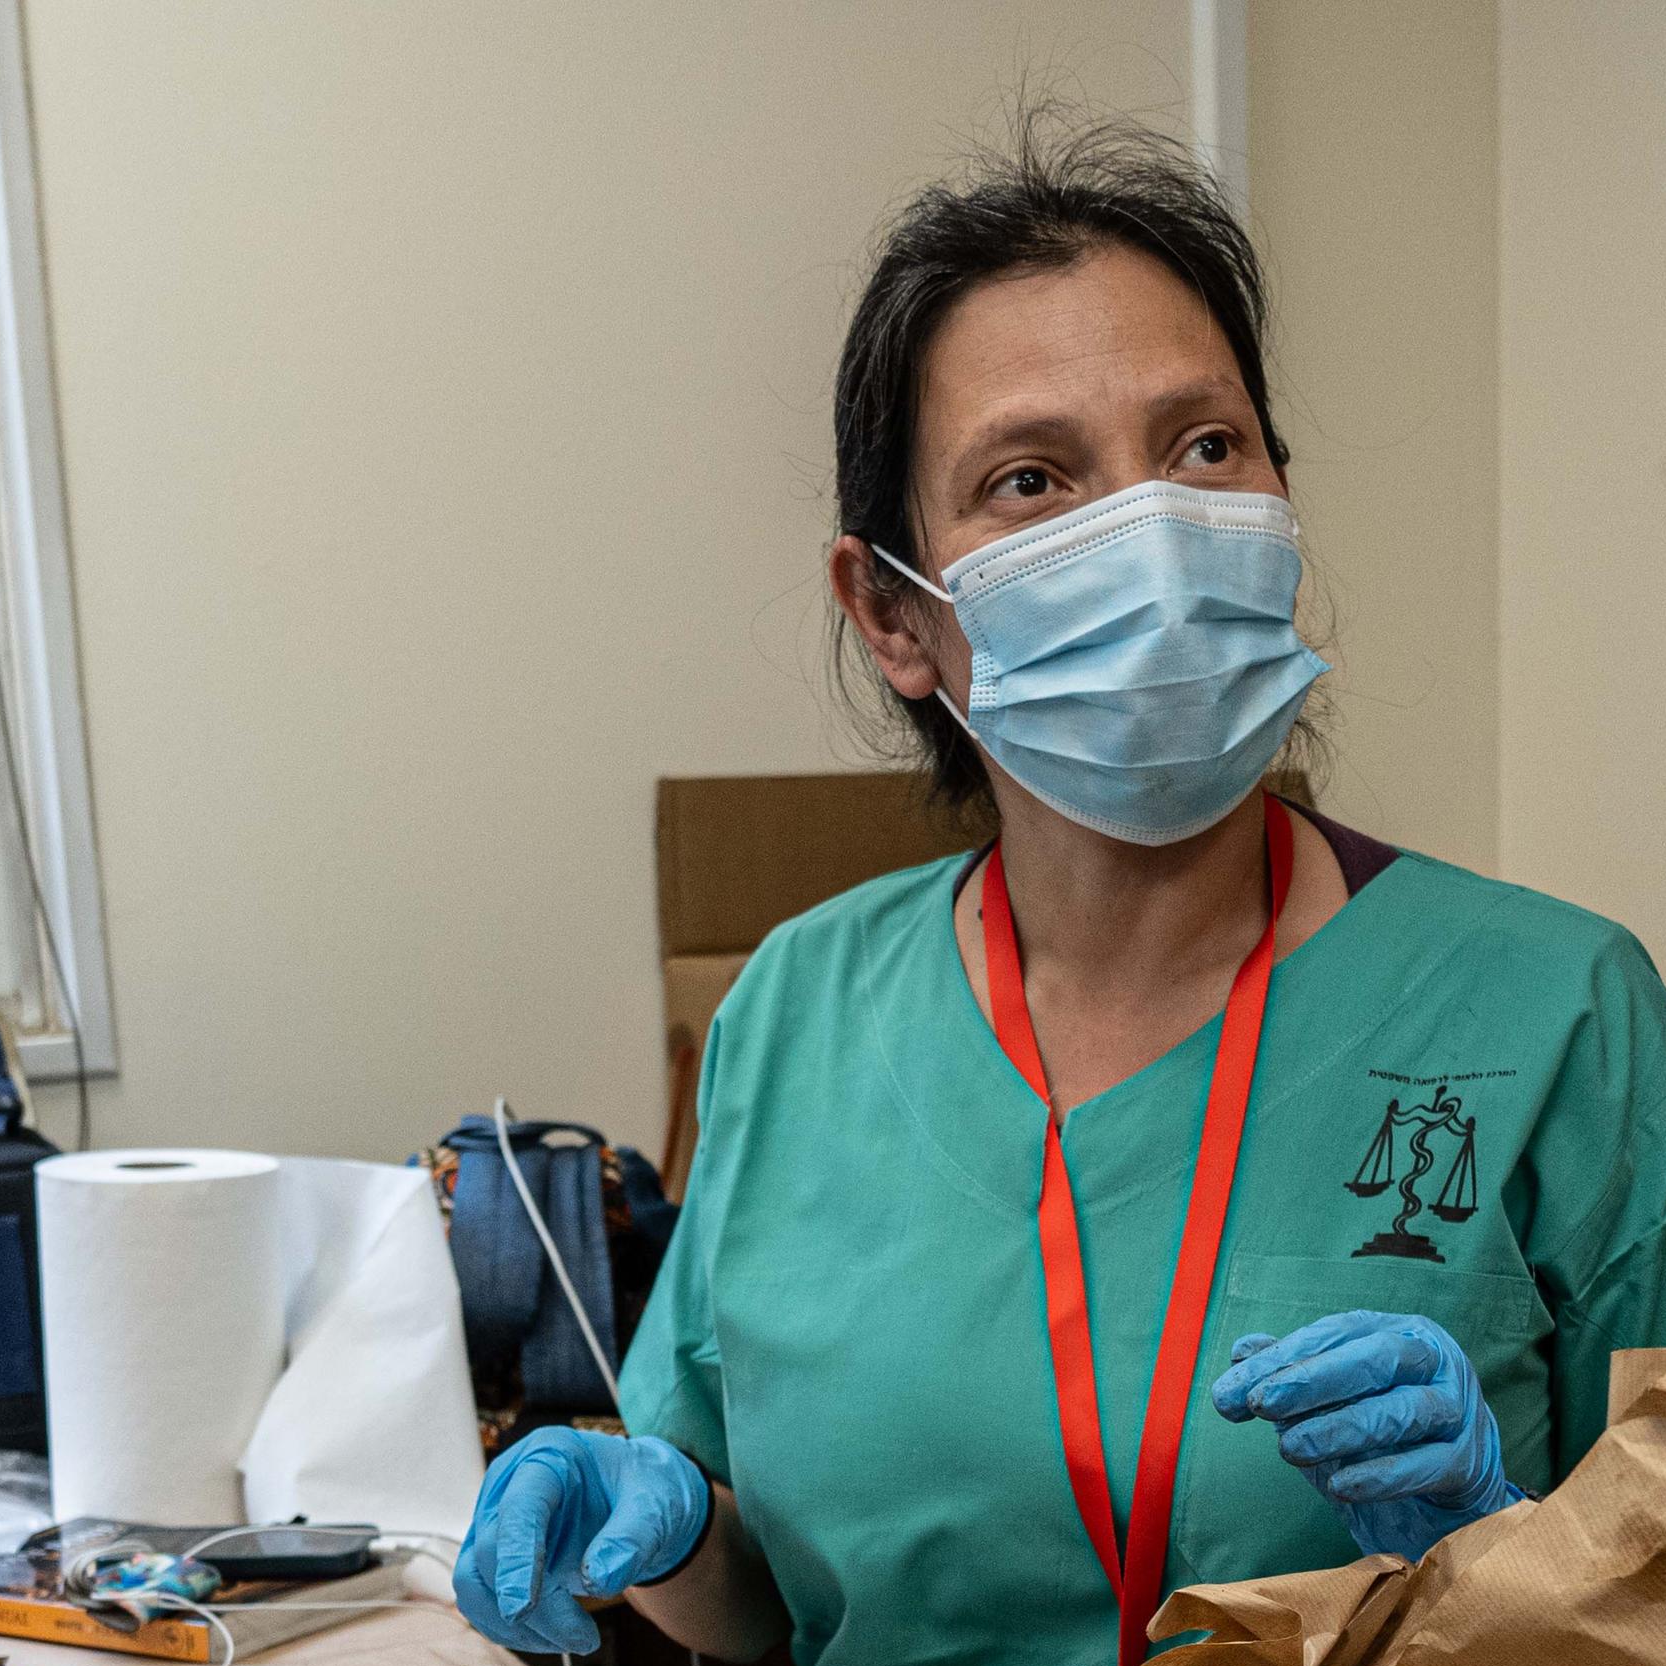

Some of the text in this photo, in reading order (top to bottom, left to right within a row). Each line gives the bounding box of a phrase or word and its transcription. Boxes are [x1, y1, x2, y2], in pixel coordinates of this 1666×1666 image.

[1368, 1069, 1517, 1087] המרכז הלאומי לרפואה משפטית
